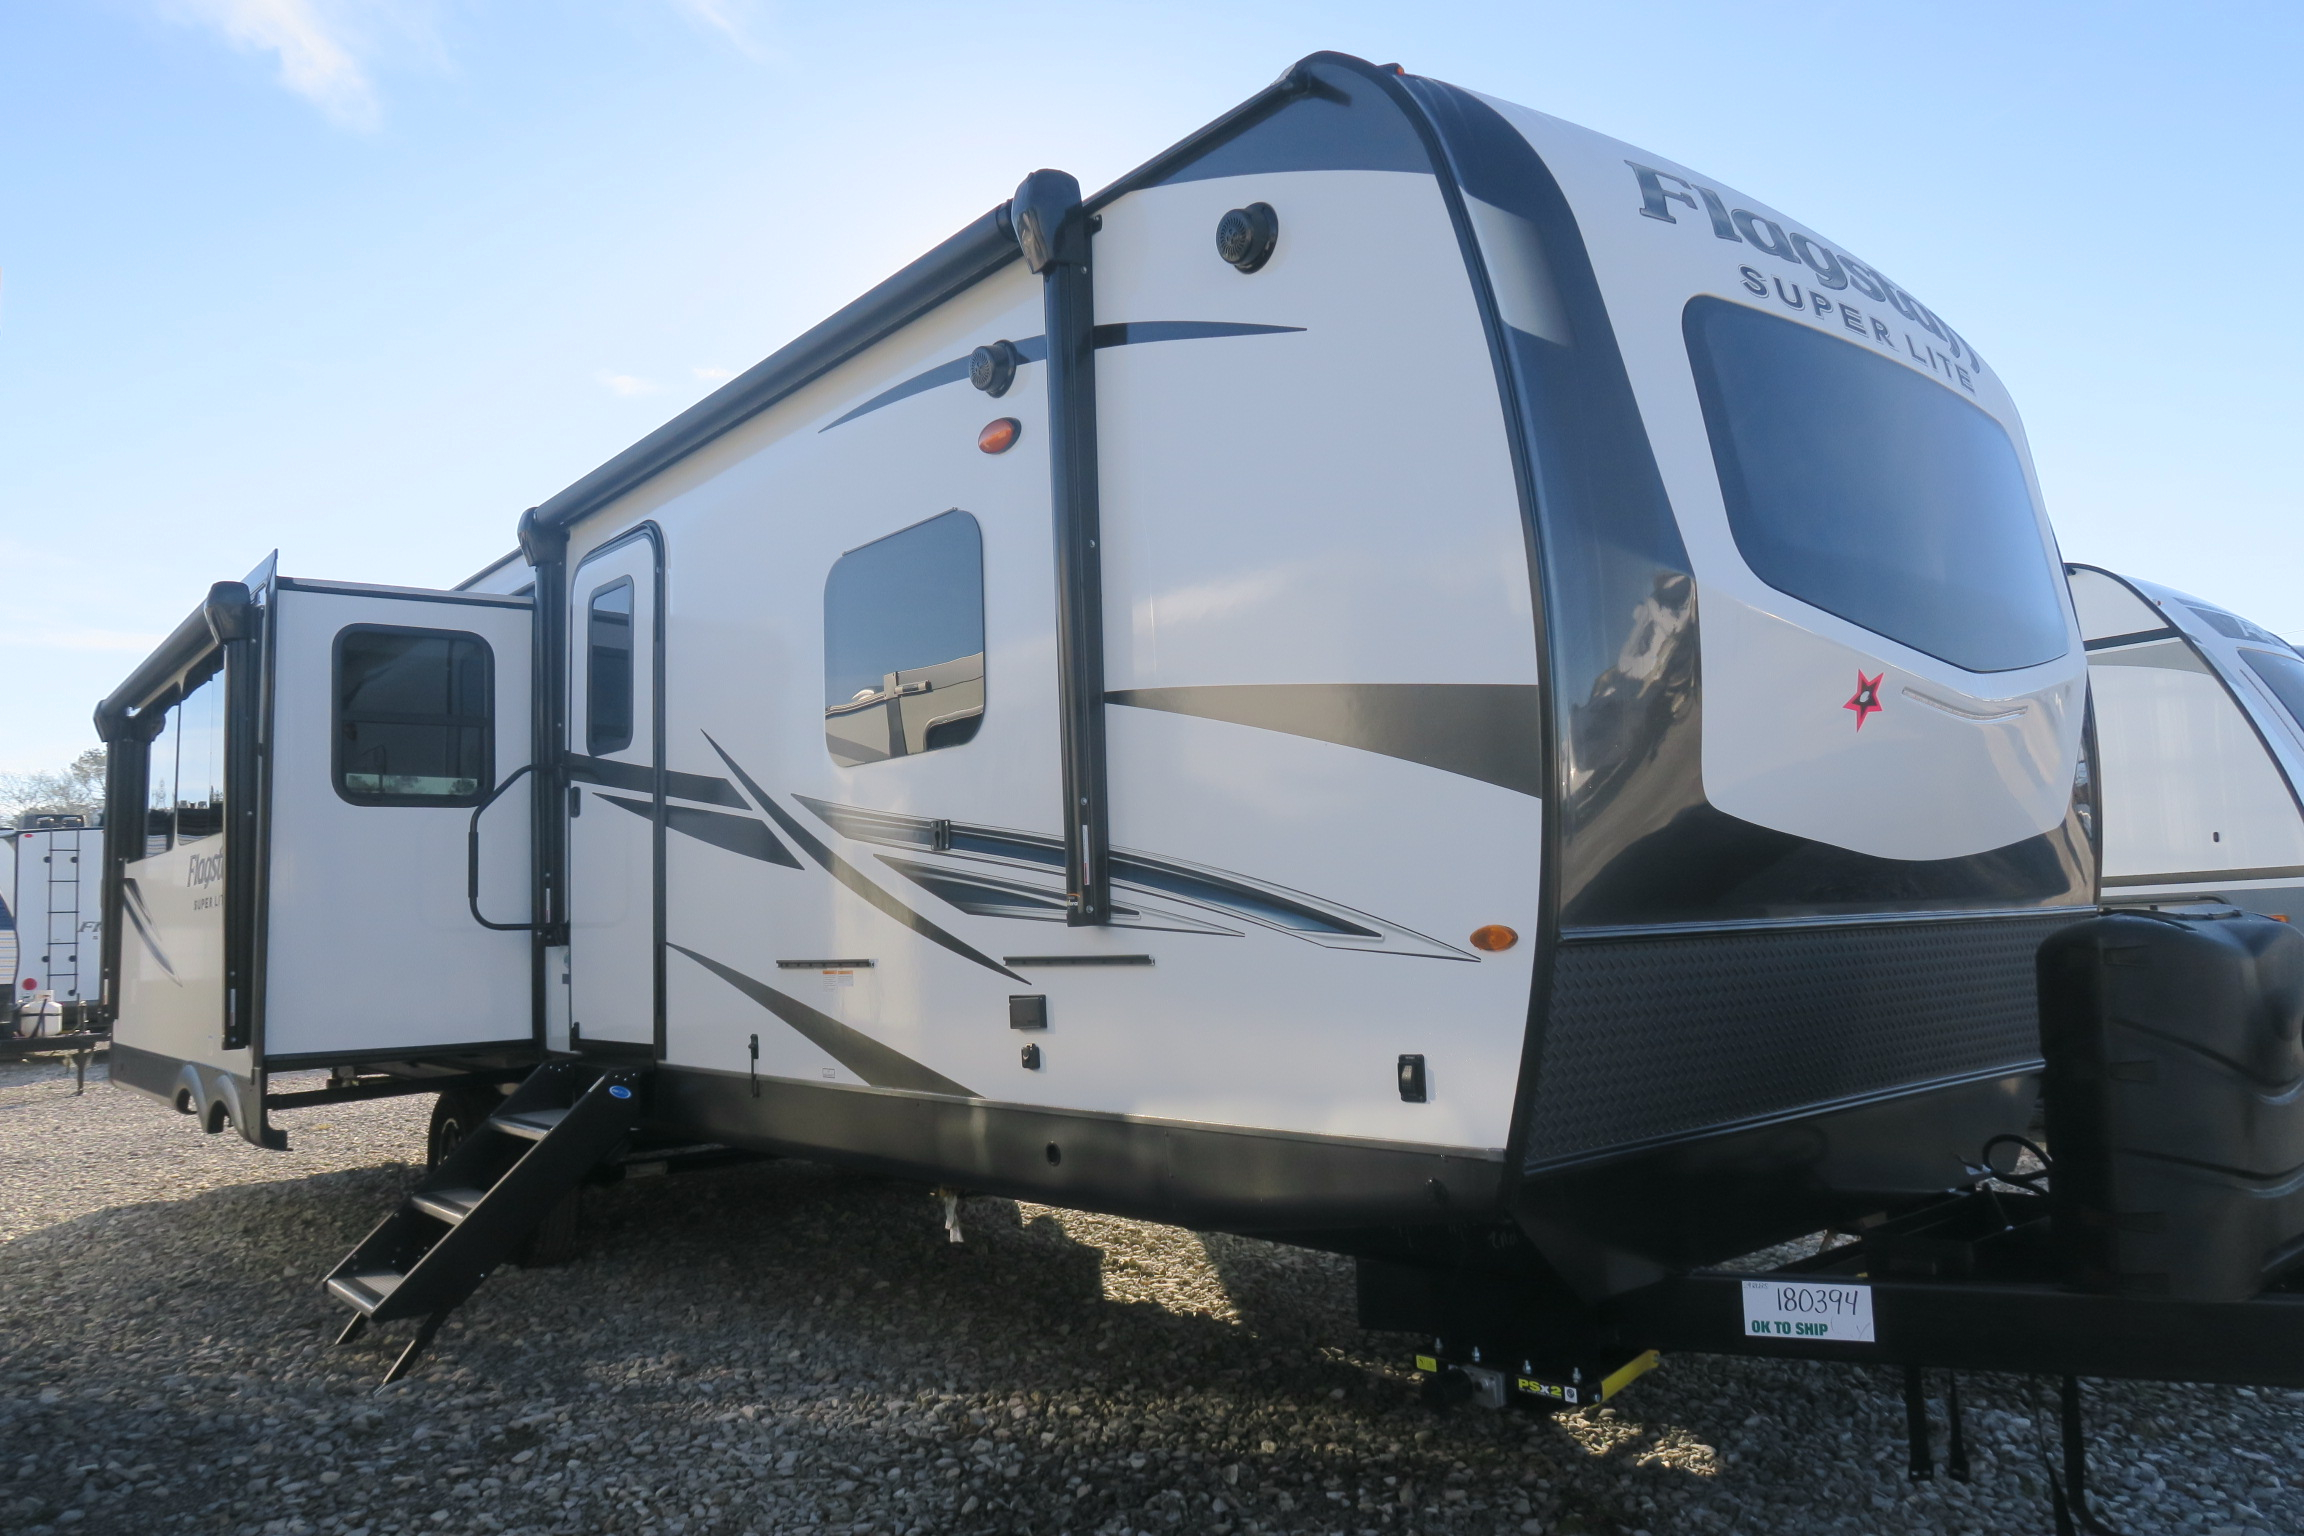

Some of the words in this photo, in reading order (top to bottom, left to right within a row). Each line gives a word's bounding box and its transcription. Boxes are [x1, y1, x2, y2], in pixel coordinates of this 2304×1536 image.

[1737, 263, 1896, 349] SUPER
[1904, 333, 1976, 397] LITE
[1777, 1287, 1858, 1316] 180394
[1751, 1319, 1771, 1334] OK
[1774, 1321, 1791, 1335] TO
[1795, 1322, 1828, 1337] SHIP
